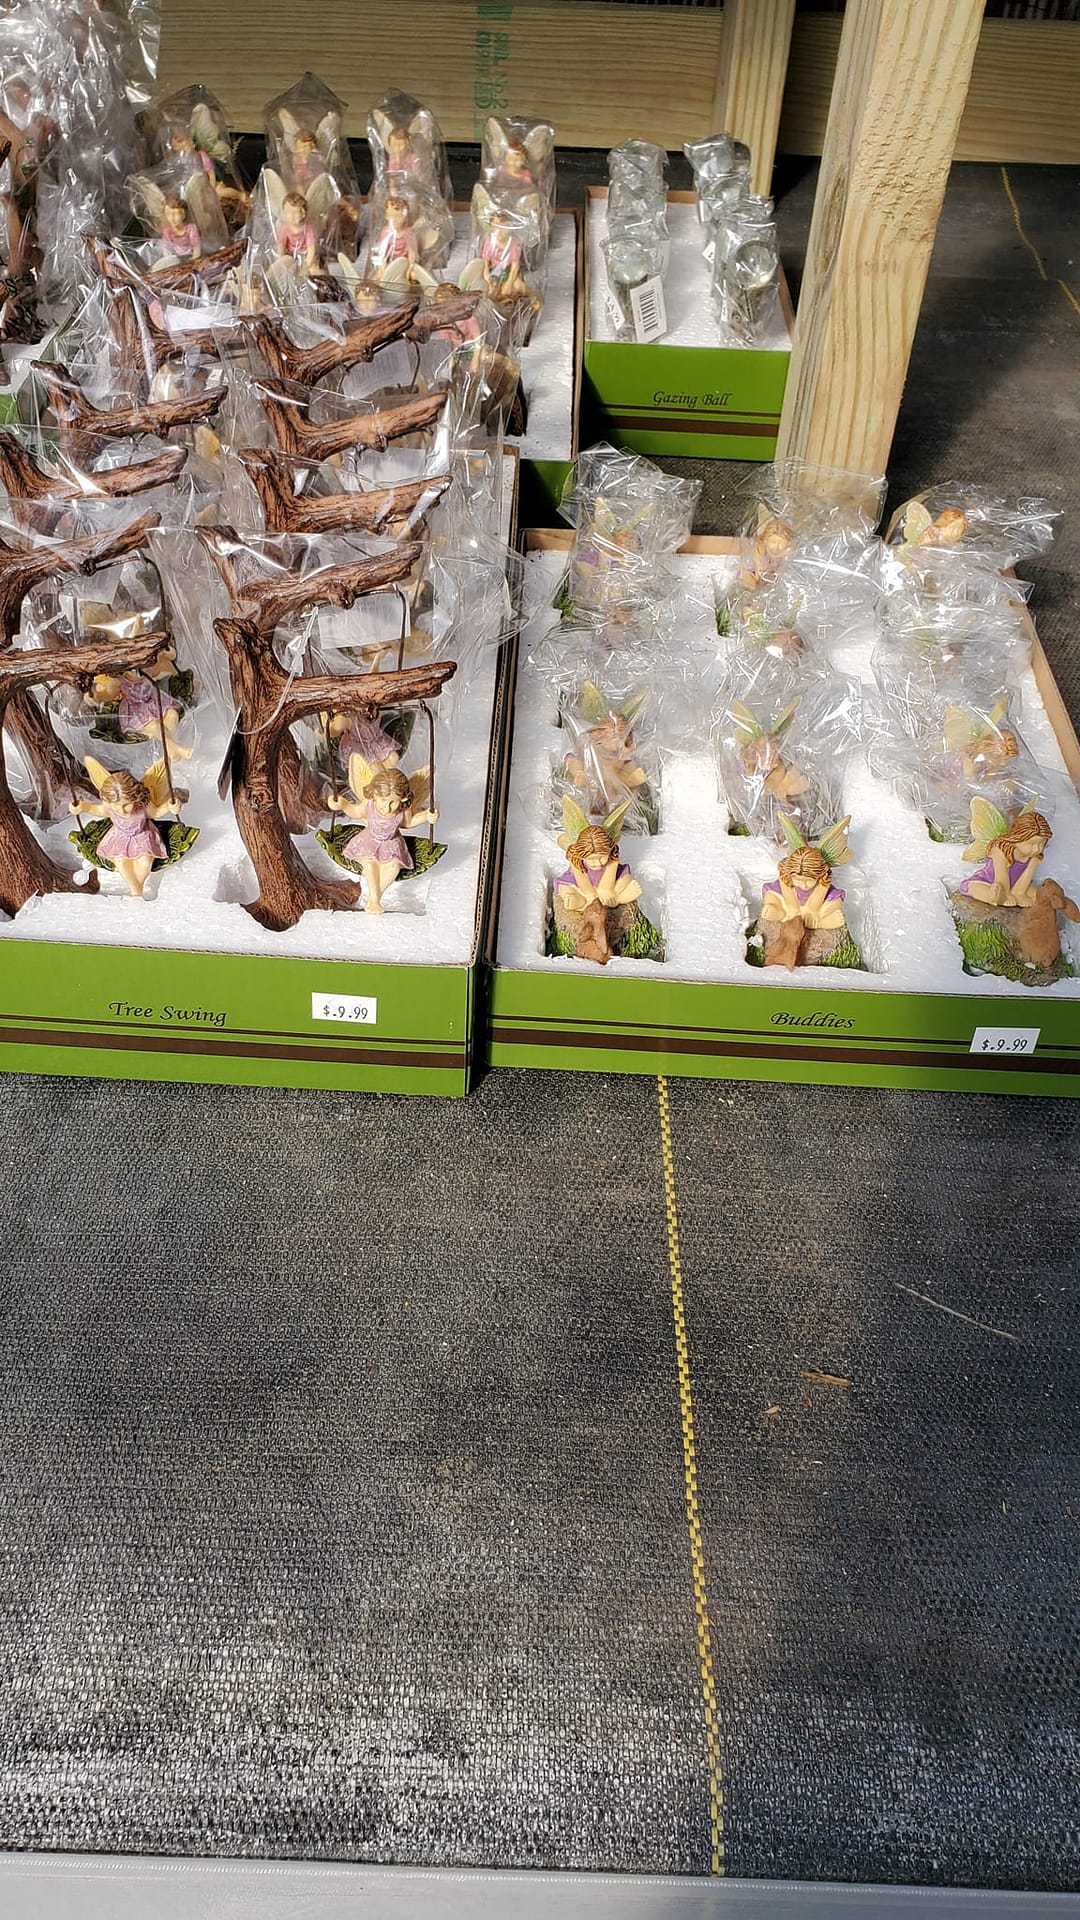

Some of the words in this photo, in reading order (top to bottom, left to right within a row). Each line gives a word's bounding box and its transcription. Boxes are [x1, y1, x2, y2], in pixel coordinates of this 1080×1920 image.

[653, 391, 699, 408] Gazing
[702, 392, 733, 406] Ball
[108, 1001, 153, 1018] Tree
[159, 1004, 227, 1027] Swing
[769, 1011, 856, 1029] Buddies
